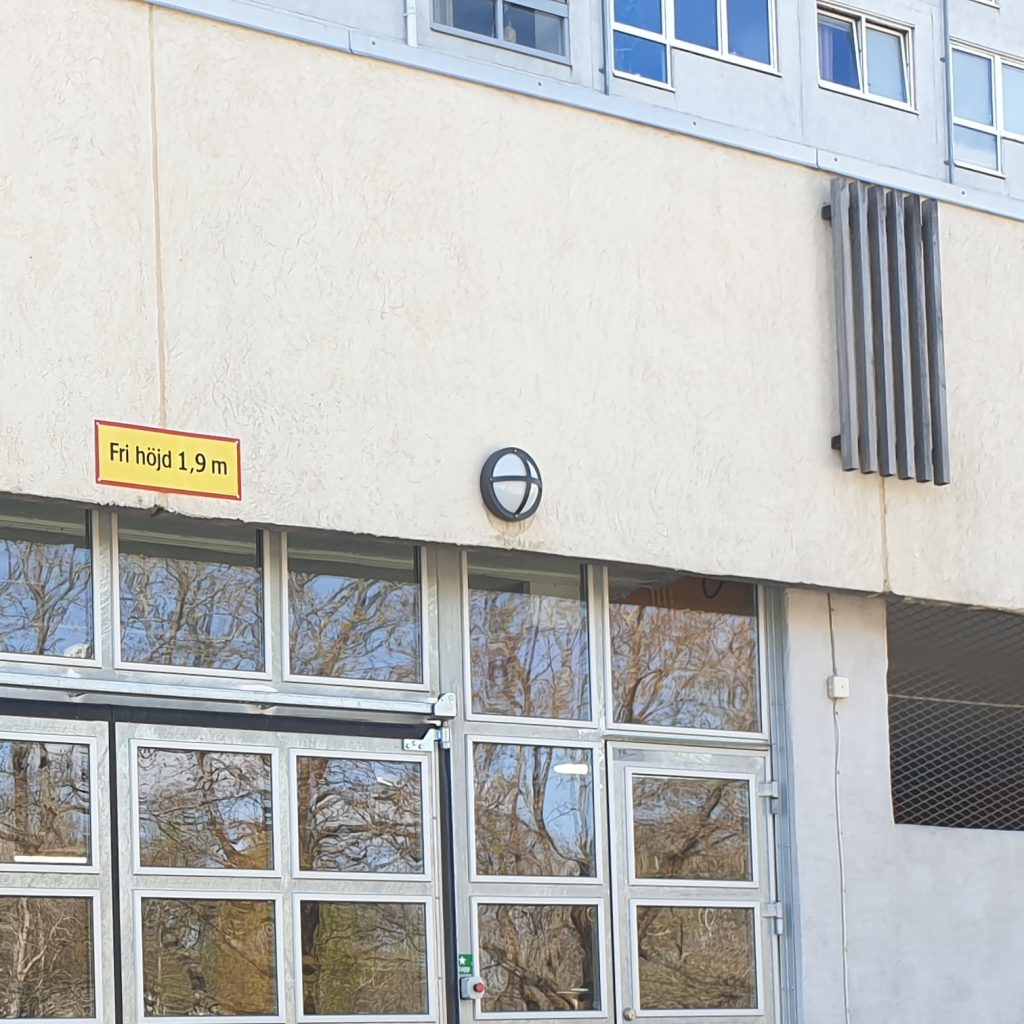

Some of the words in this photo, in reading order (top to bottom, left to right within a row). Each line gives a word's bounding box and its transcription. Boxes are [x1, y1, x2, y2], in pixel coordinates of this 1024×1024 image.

[109, 442, 129, 463] Fri
[135, 445, 172, 471] höjd
[178, 451, 206, 474] 1,9
[211, 459, 228, 475] m
